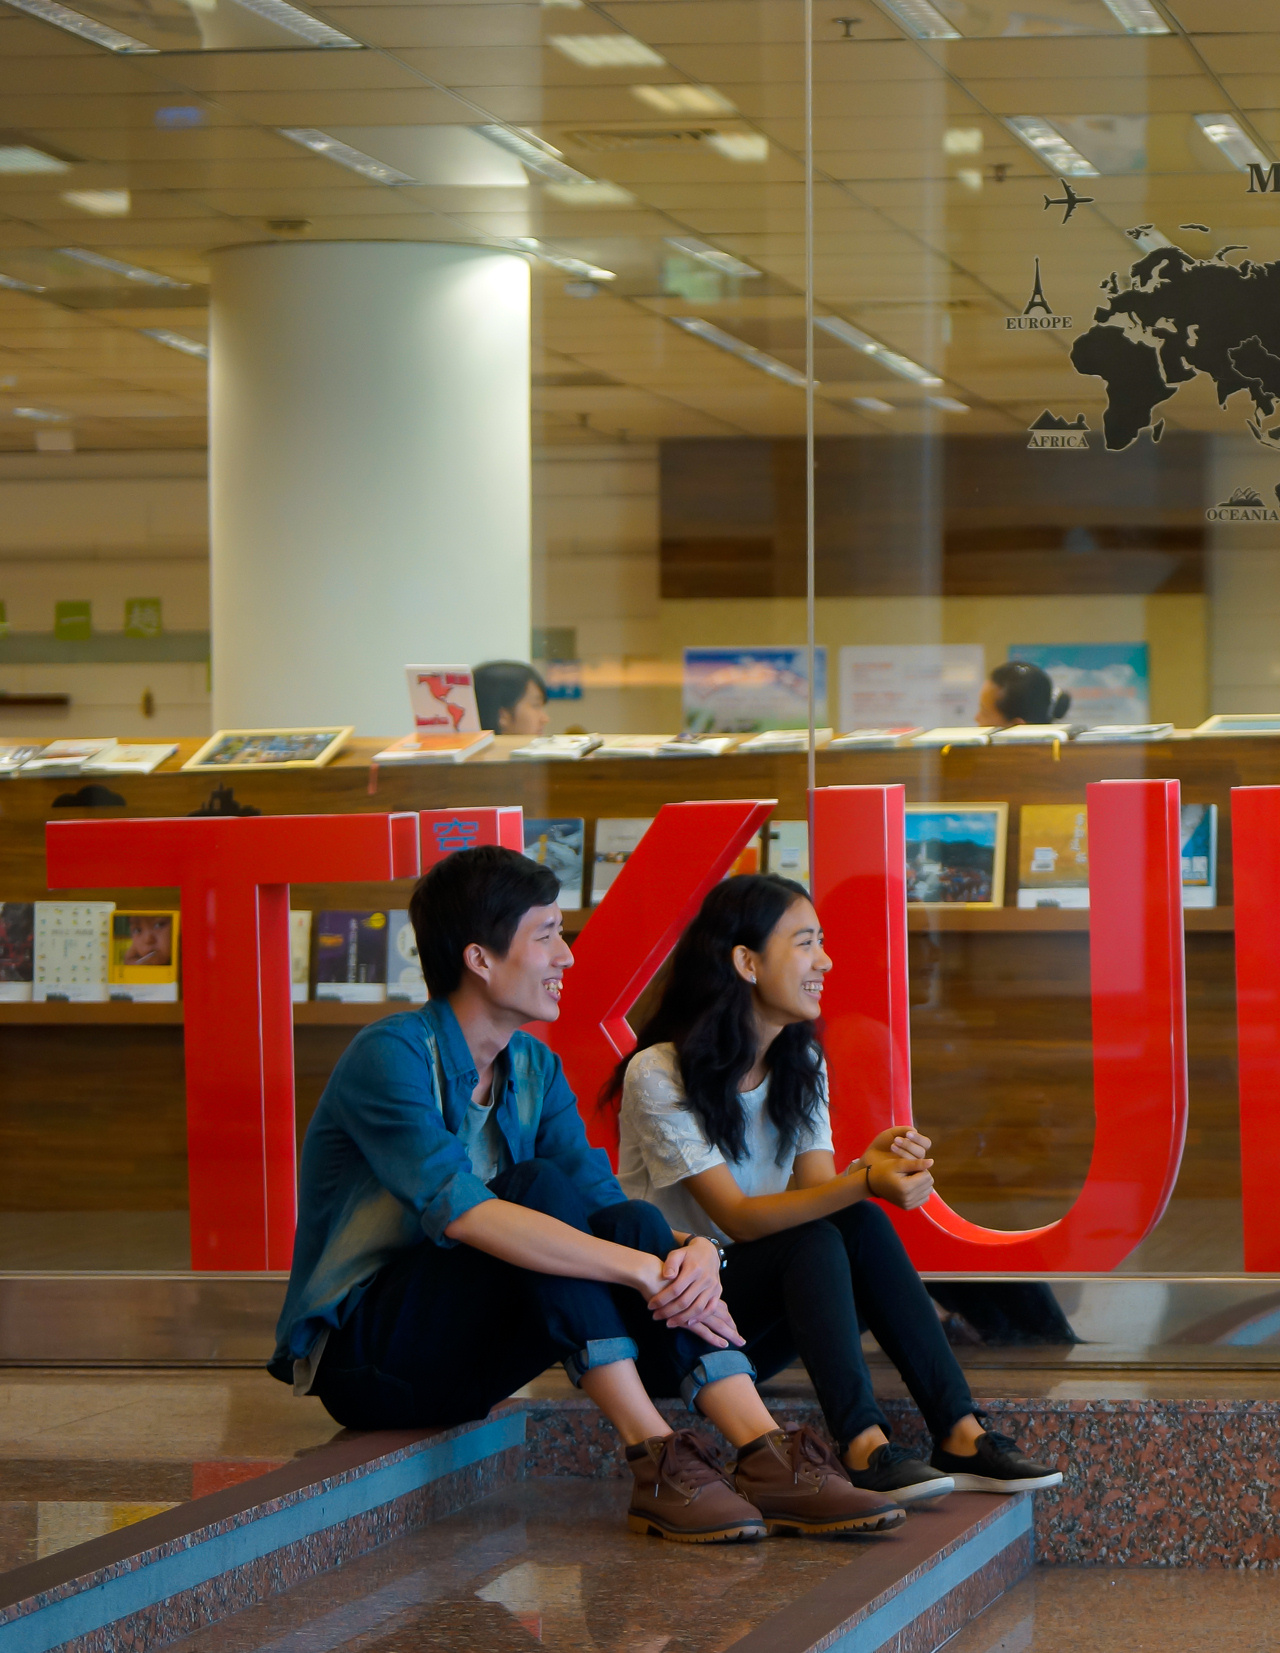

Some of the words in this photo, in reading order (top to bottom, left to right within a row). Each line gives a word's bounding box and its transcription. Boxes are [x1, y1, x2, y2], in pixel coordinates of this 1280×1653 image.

[1005, 315, 1073, 331] EUROPE
[1028, 434, 1089, 448] AFRICA
[1206, 507, 1280, 521] OCEANIA
